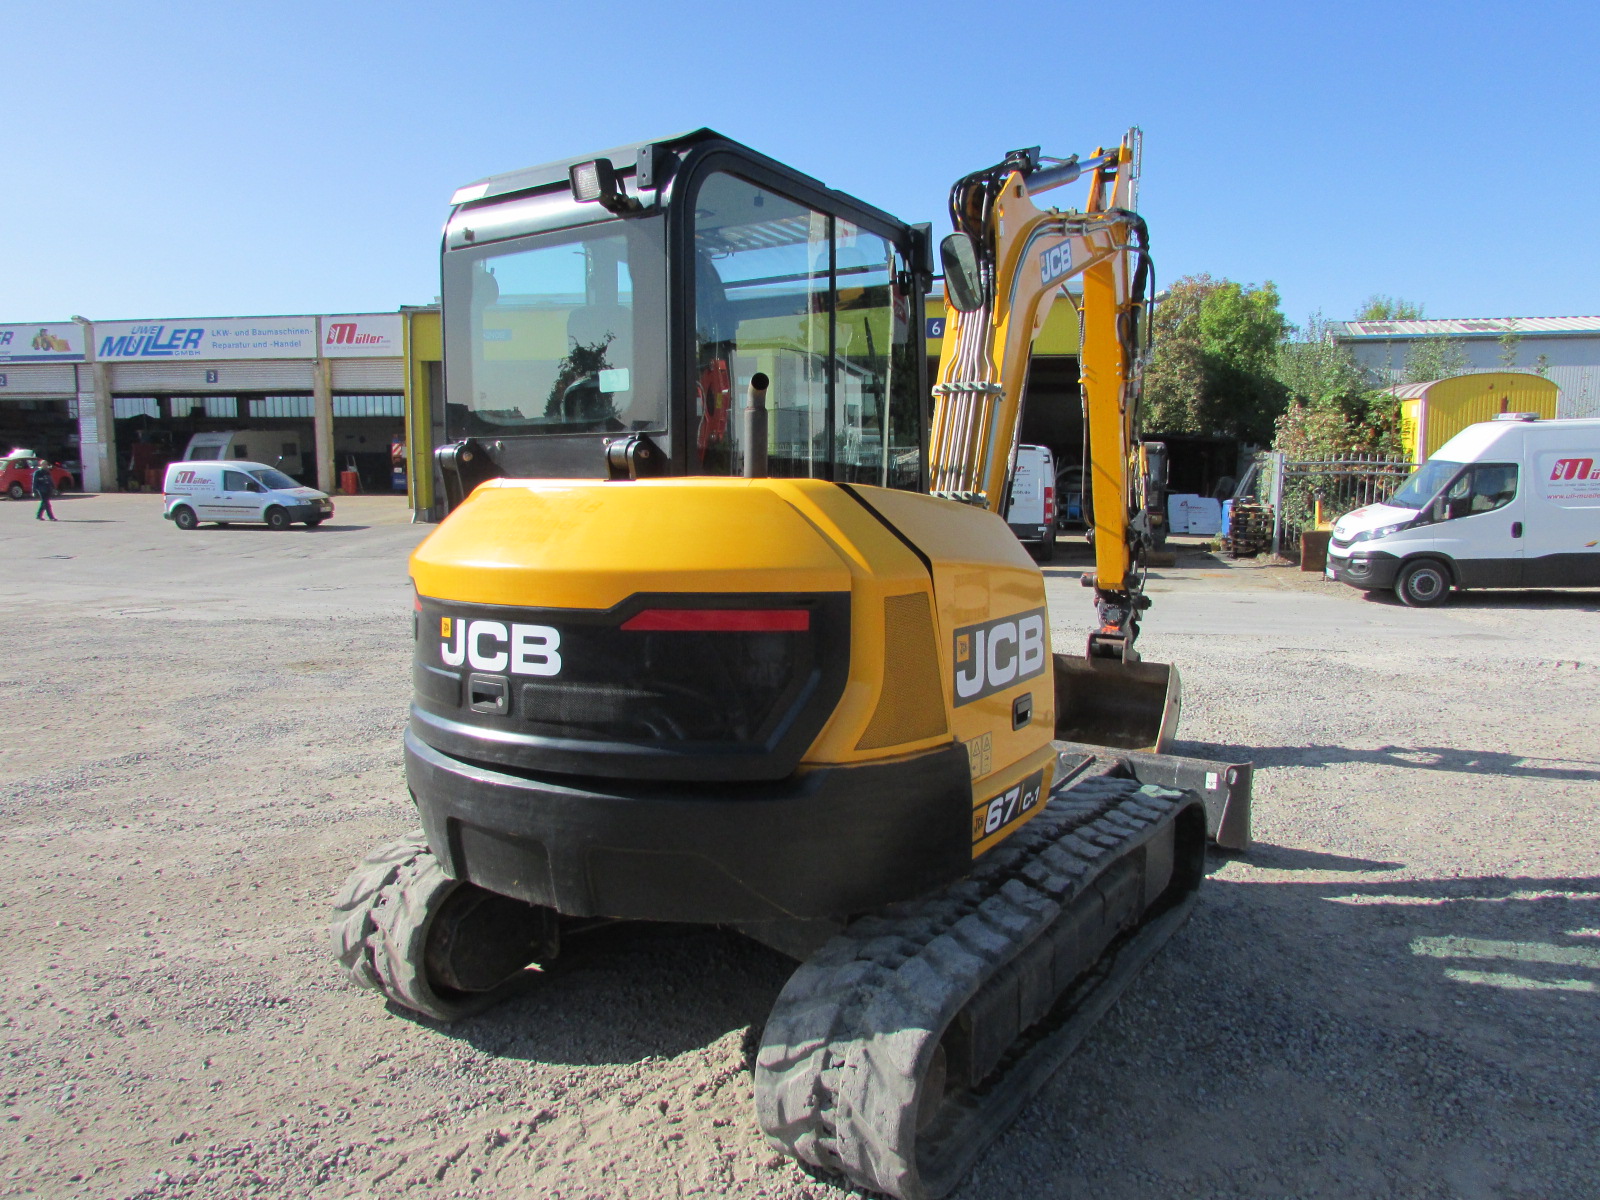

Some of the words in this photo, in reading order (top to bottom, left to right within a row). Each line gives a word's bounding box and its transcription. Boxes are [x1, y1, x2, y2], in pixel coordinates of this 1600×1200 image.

[1041, 242, 1072, 283] JCB
[131, 326, 159, 335] UWE
[211, 329, 232, 337] LKW-
[235, 329, 250, 337] und
[252, 328, 313, 336] Baumaschinen-
[326, 323, 384, 344] Müller
[932, 321, 940, 335] 6
[212, 341, 250, 349] Reparatur
[270, 340, 302, 348] -Handel
[209, 372, 215, 382] 3
[441, 618, 561, 676] JCB
[956, 614, 1044, 698] JCB
[986, 786, 1020, 834] 67
